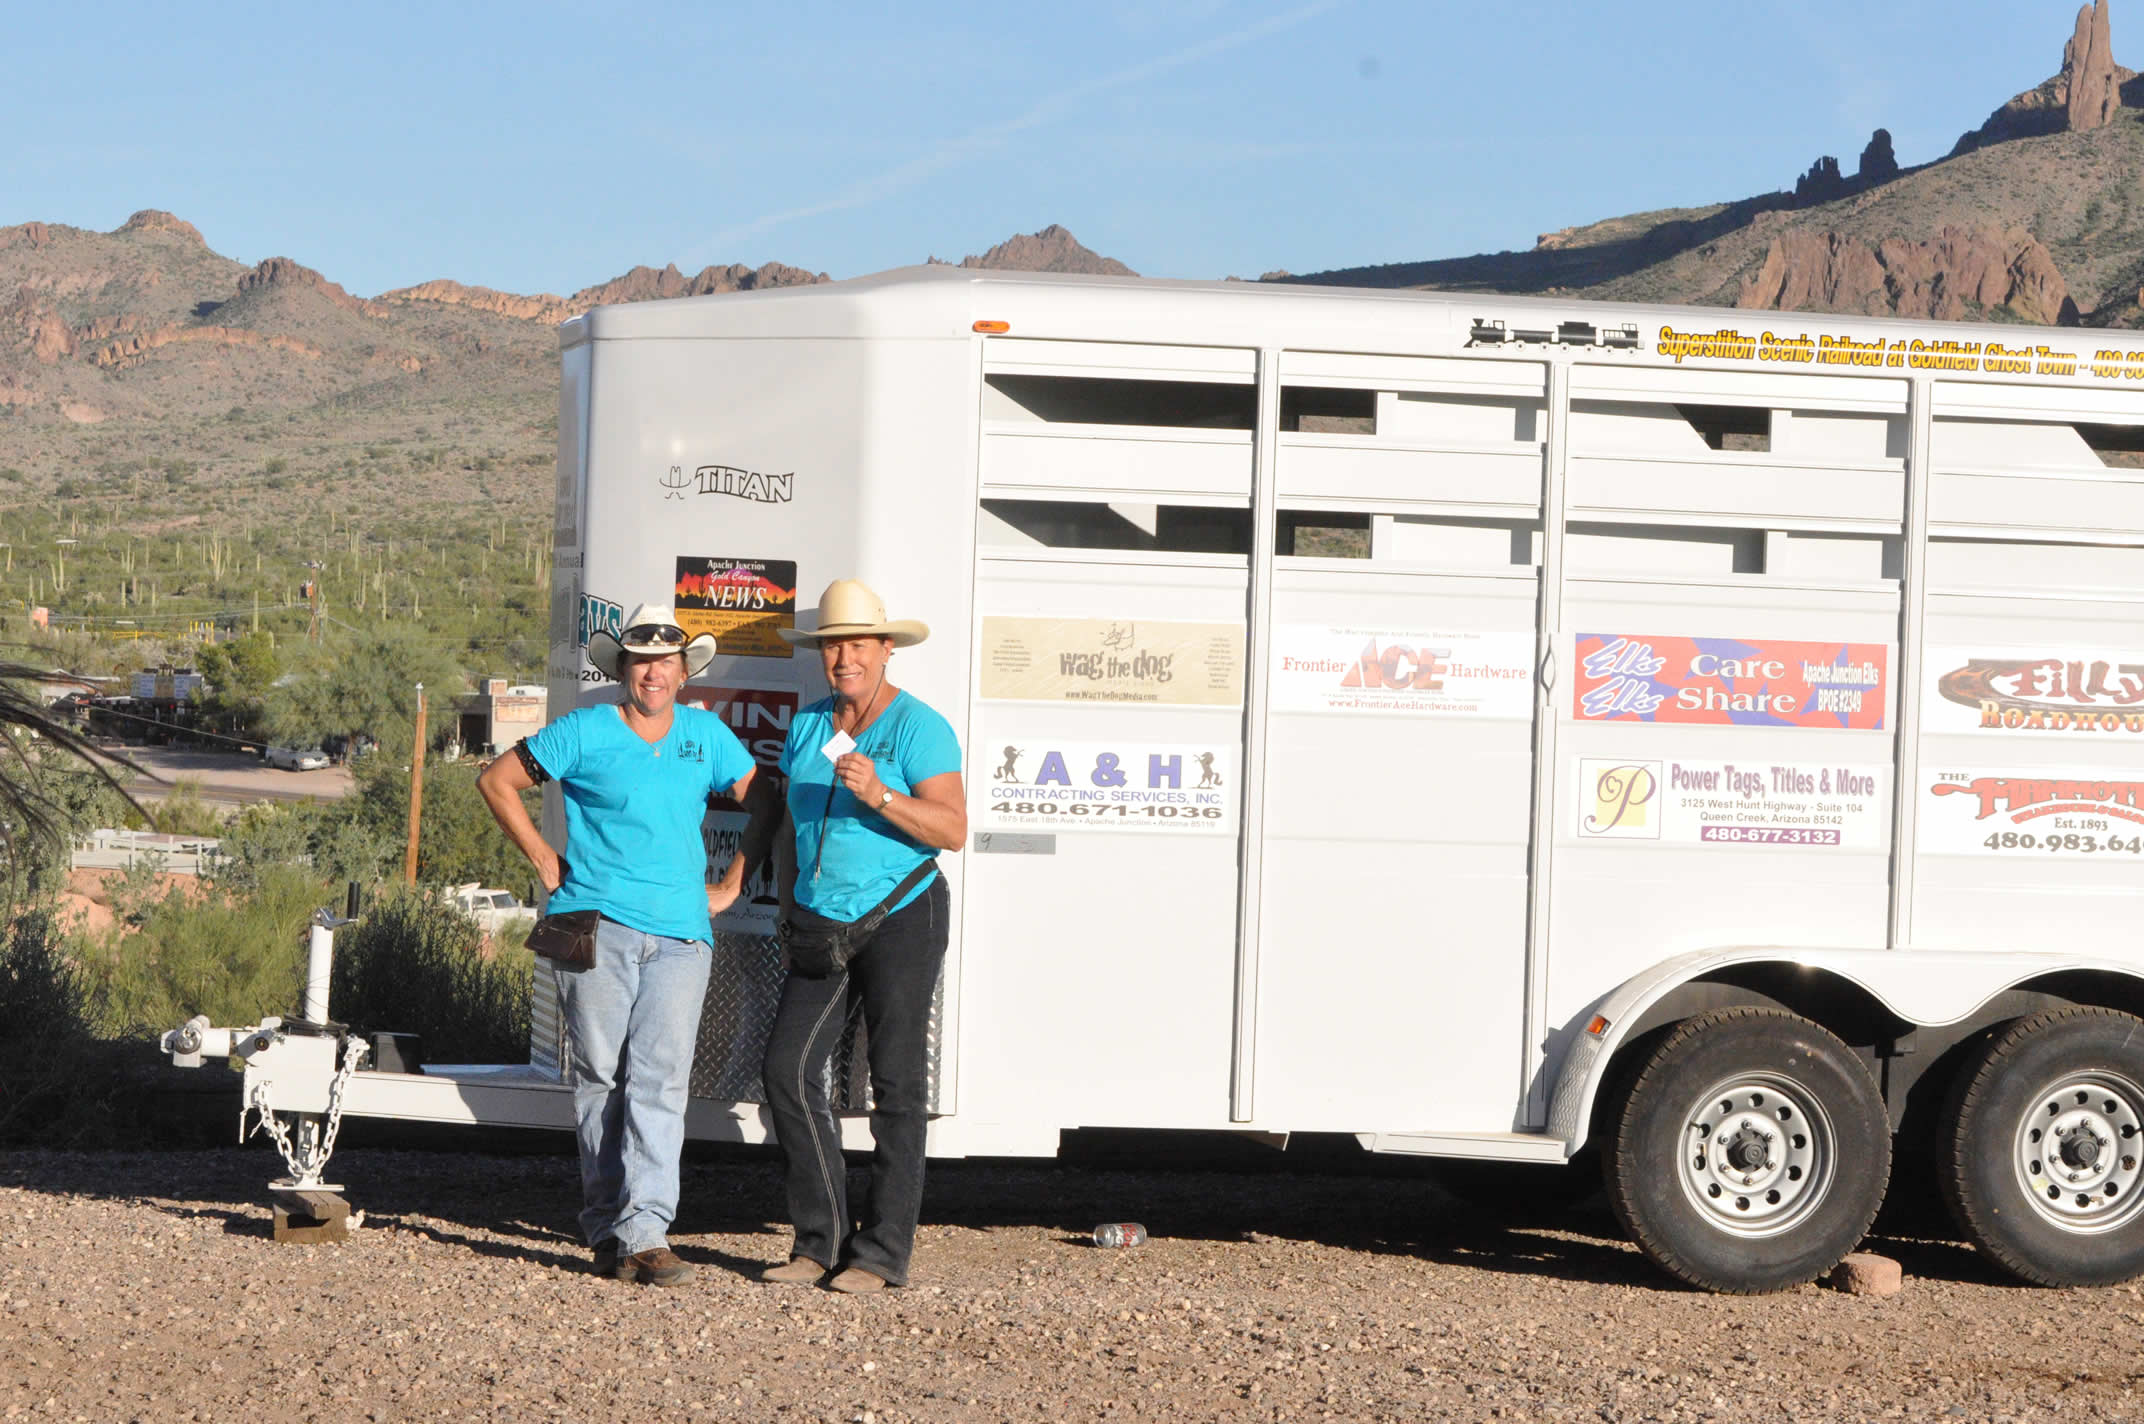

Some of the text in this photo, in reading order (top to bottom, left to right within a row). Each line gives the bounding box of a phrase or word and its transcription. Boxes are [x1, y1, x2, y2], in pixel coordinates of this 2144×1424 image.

[1658, 326, 1756, 363] Superstition
[1759, 331, 1815, 363] Scenic
[1817, 335, 1885, 366] Railroad
[1887, 340, 1906, 367] at
[1908, 339, 1980, 371] Goldfield
[1983, 343, 2032, 374] Ghost
[2036, 346, 2077, 376] Town
[695, 465, 794, 503] TITAN
[710, 571, 729, 583] Gold
[704, 585, 767, 609] NEWS
[1107, 656, 1131, 679] the
[1132, 649, 1175, 683] dog
[1282, 656, 1348, 673] Frontier
[1340, 637, 1452, 690] ACE
[1450, 664, 1527, 679] Hardware
[1583, 638, 1667, 678] Elks
[1690, 654, 1785, 680] Care
[1803, 660, 1879, 688] Apache Junction Elks
[1328, 699, 1478, 712] www.FrontierAceHardware.com
[1581, 676, 1665, 716] Elks
[1676, 686, 1797, 714] Share
[1034, 751, 1182, 789] A & H
[1671, 763, 1875, 799] Power Tags, Titles & More
[1938, 773, 1969, 781] THE
[991, 787, 1223, 805] CONTRACTING SERVICES, INC.
[1681, 798, 1705, 808] 3125
[1707, 799, 1733, 809] West
[1736, 800, 1760, 810] Hunt
[1764, 801, 1807, 813] Highway
[1816, 802, 1842, 812] Suite
[1846, 803, 1863, 813] 104
[990, 802, 1223, 819] 480.671-1036
[1019, 815, 1039, 823] East
[1700, 811, 1843, 825] Queen Creek, Arizona 85142
[1705, 827, 1837, 844] 480-677-3132
[2054, 817, 2108, 831] Est. 1893
